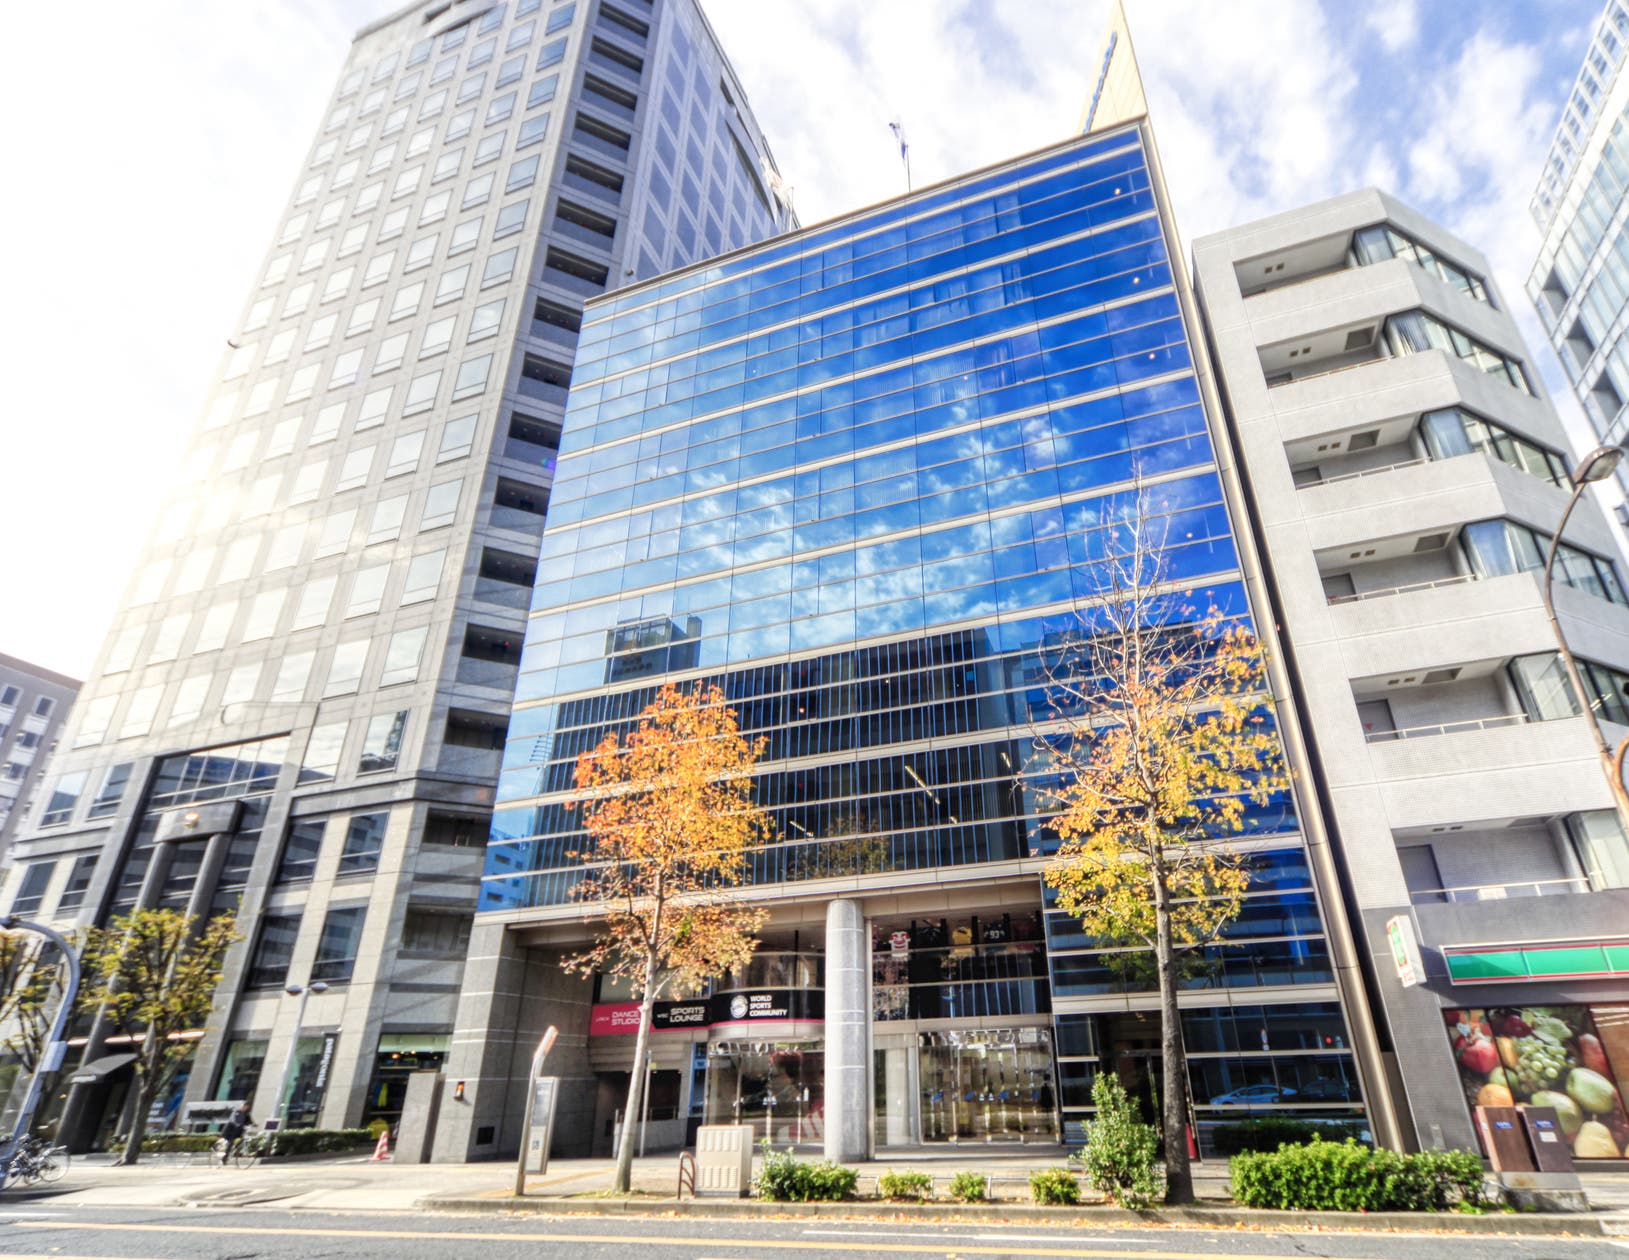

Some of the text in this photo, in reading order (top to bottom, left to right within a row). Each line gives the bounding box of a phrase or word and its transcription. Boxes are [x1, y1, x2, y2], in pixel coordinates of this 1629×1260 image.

[750, 1002, 772, 1010] SPORTS
[611, 1010, 639, 1019] DANCE
[670, 1006, 704, 1016] SPORTS
[749, 1009, 788, 1017] COMMUNITY
[611, 1017, 640, 1026] STUDIO
[669, 1014, 704, 1023] LOUNGE
